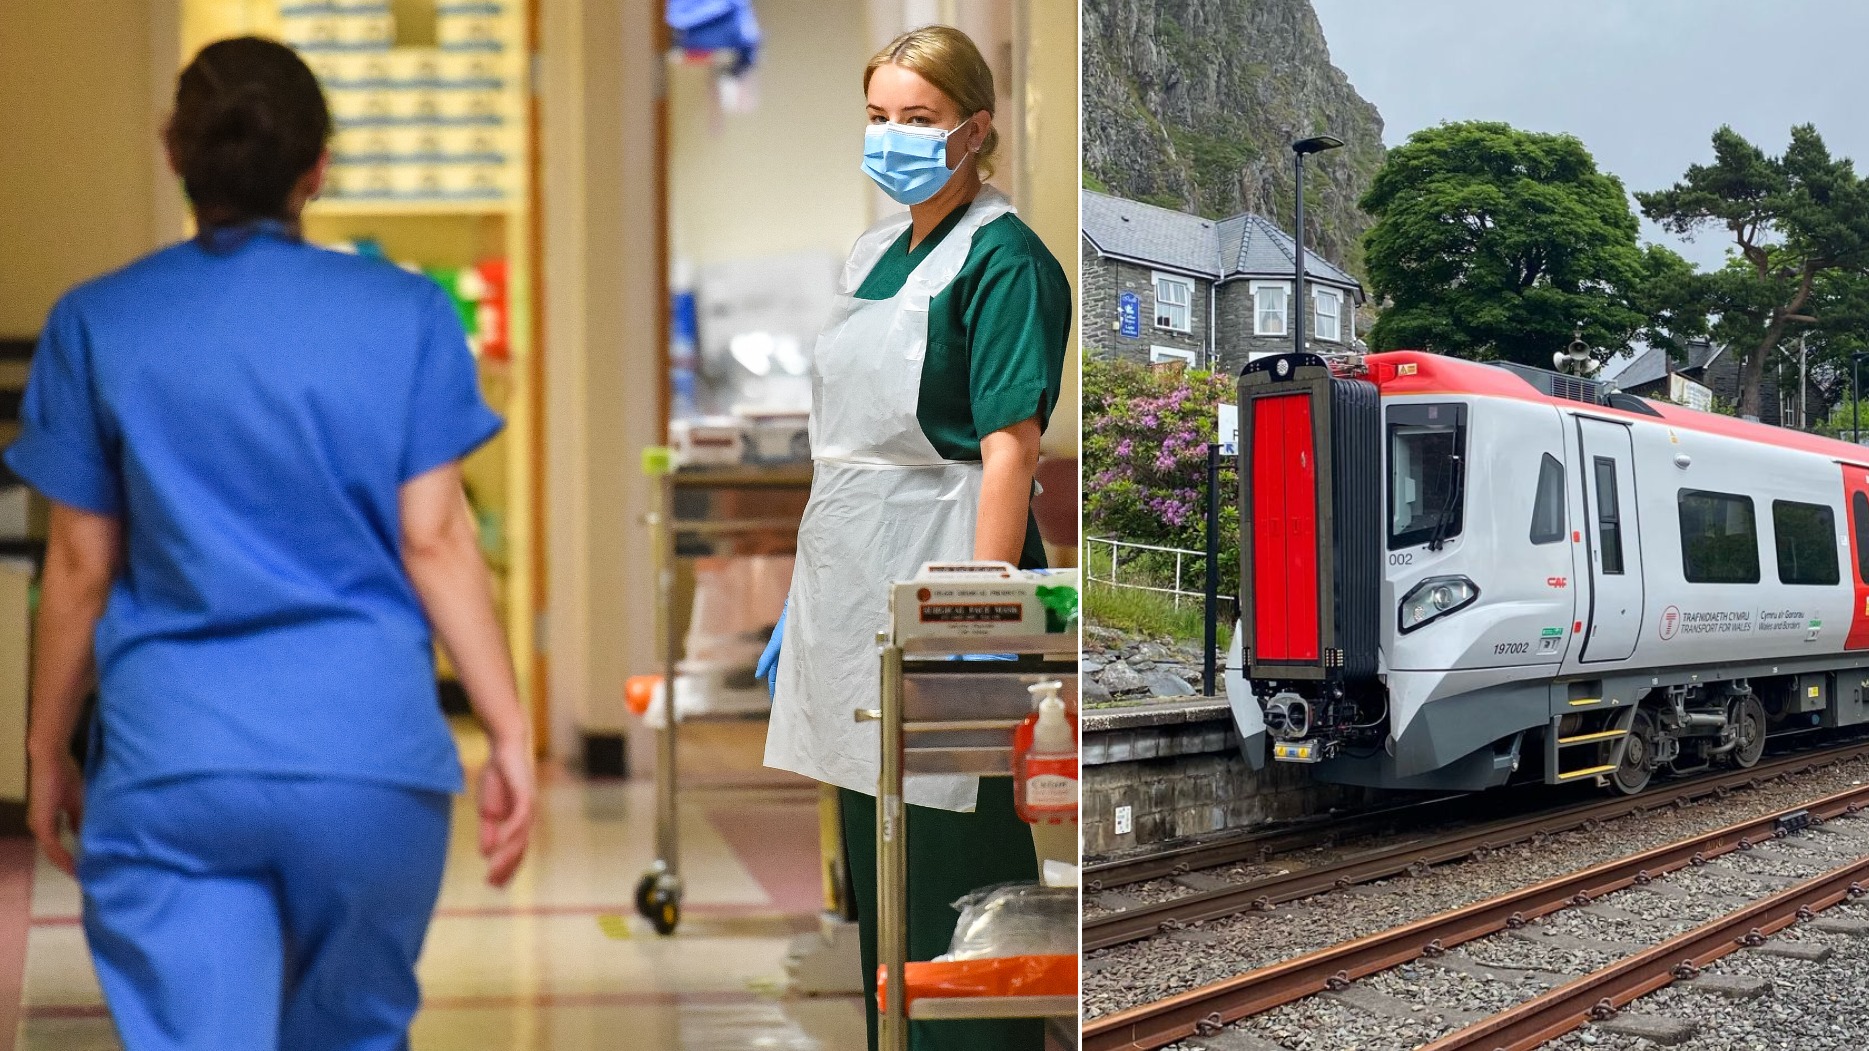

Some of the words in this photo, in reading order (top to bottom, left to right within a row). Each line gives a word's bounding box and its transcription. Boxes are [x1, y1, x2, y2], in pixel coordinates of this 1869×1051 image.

[1389, 553, 1413, 566] 002
[1729, 610, 1750, 621] CYMRU
[1760, 610, 1778, 621] Cymru
[1681, 622, 1719, 633] TRANSPORT
[1718, 622, 1731, 632] FOR
[1731, 621, 1752, 632] WALES
[1493, 642, 1530, 655] 197002
